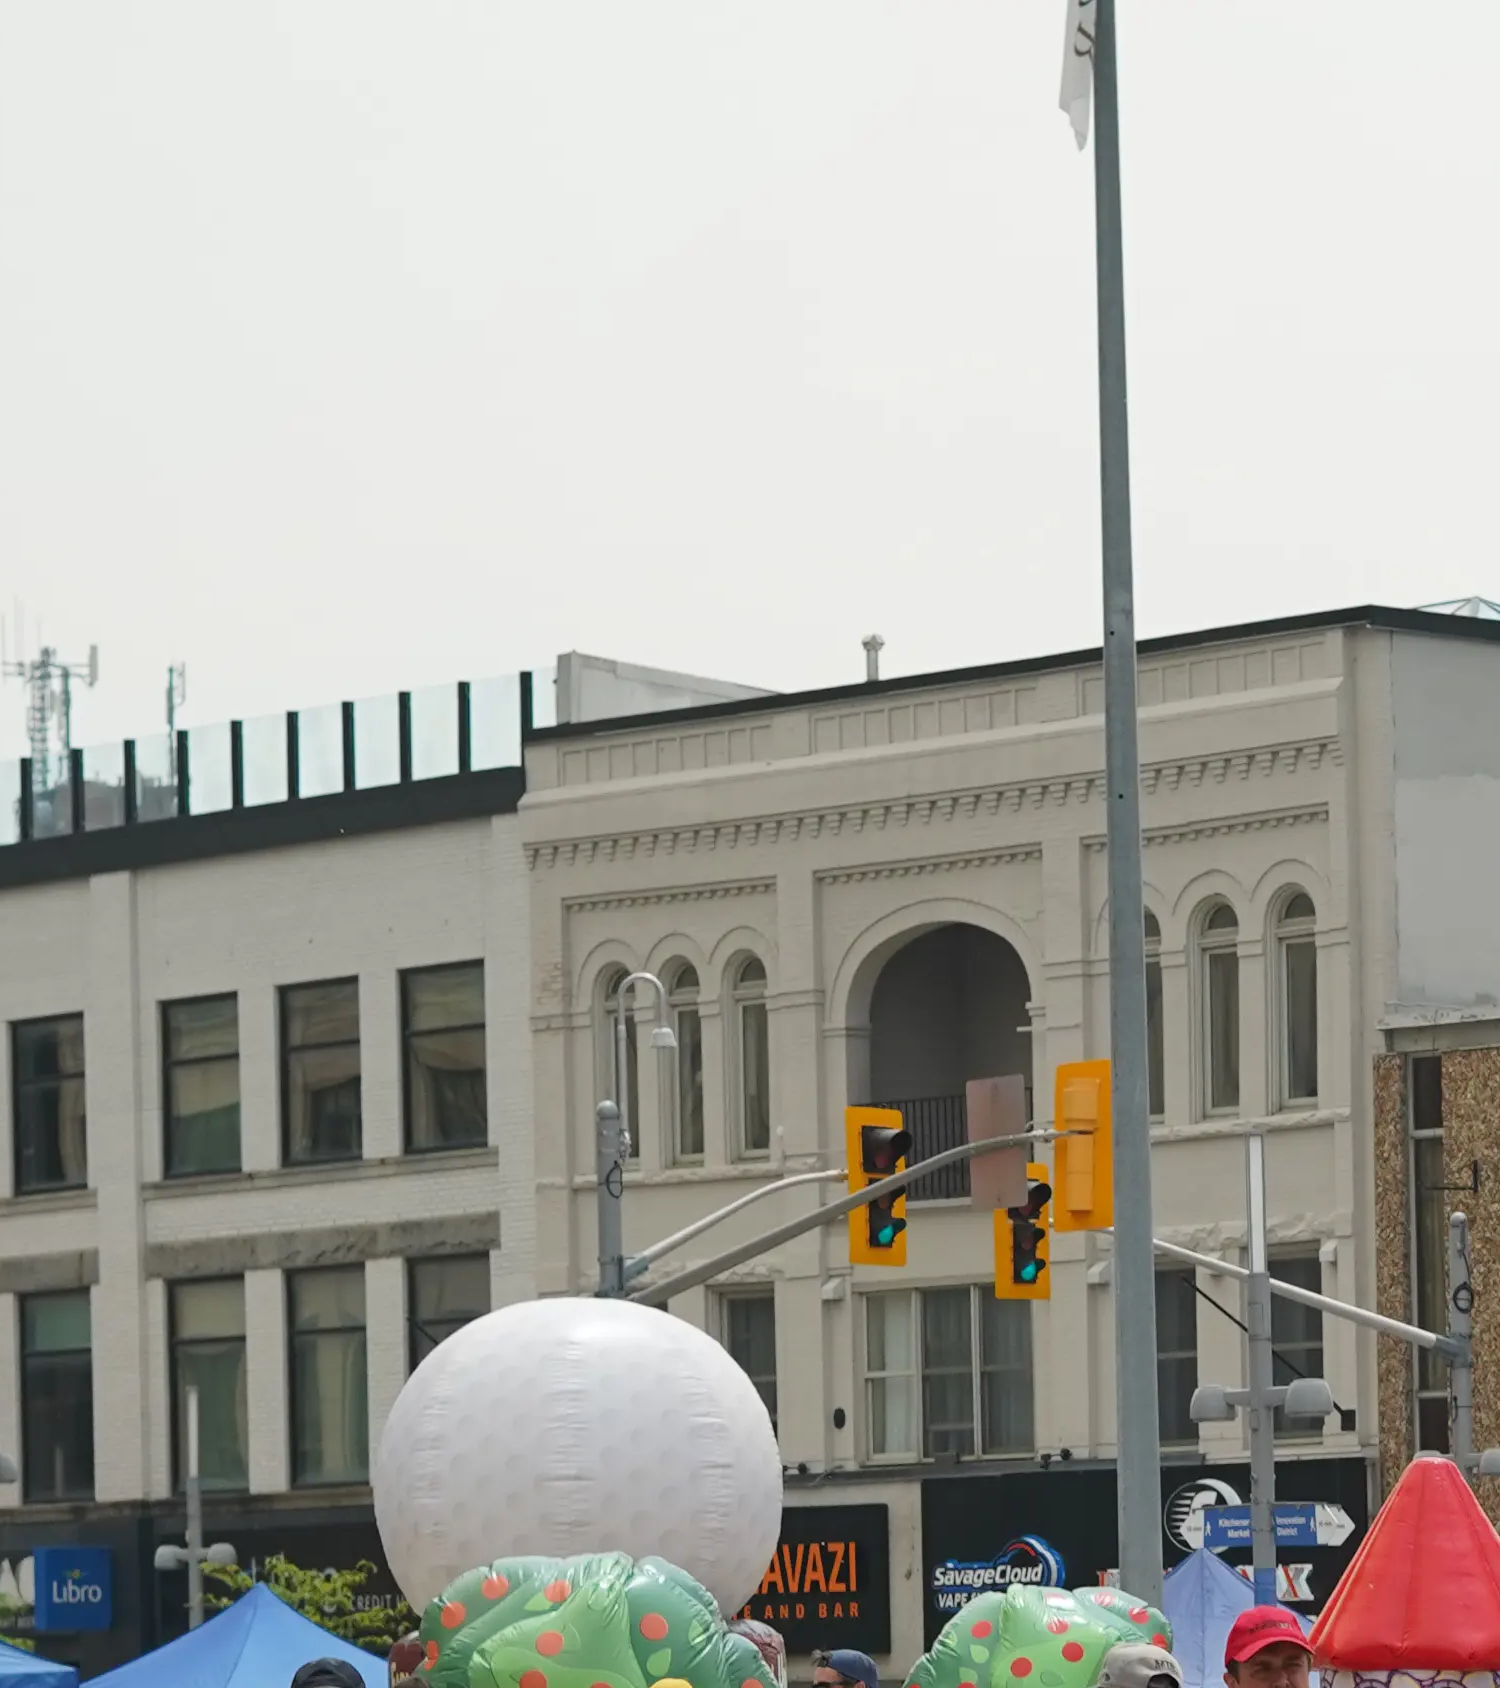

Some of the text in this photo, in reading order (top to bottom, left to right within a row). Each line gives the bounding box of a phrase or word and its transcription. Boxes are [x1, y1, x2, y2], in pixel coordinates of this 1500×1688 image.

[756, 1541, 857, 1595] AVAZI
[934, 1563, 1043, 1588] SavageCloud
[52, 1579, 102, 1603] Libro
[351, 1594, 392, 1612] CREDIT
[764, 1603, 805, 1620] AND
[818, 1601, 860, 1619] BAR
